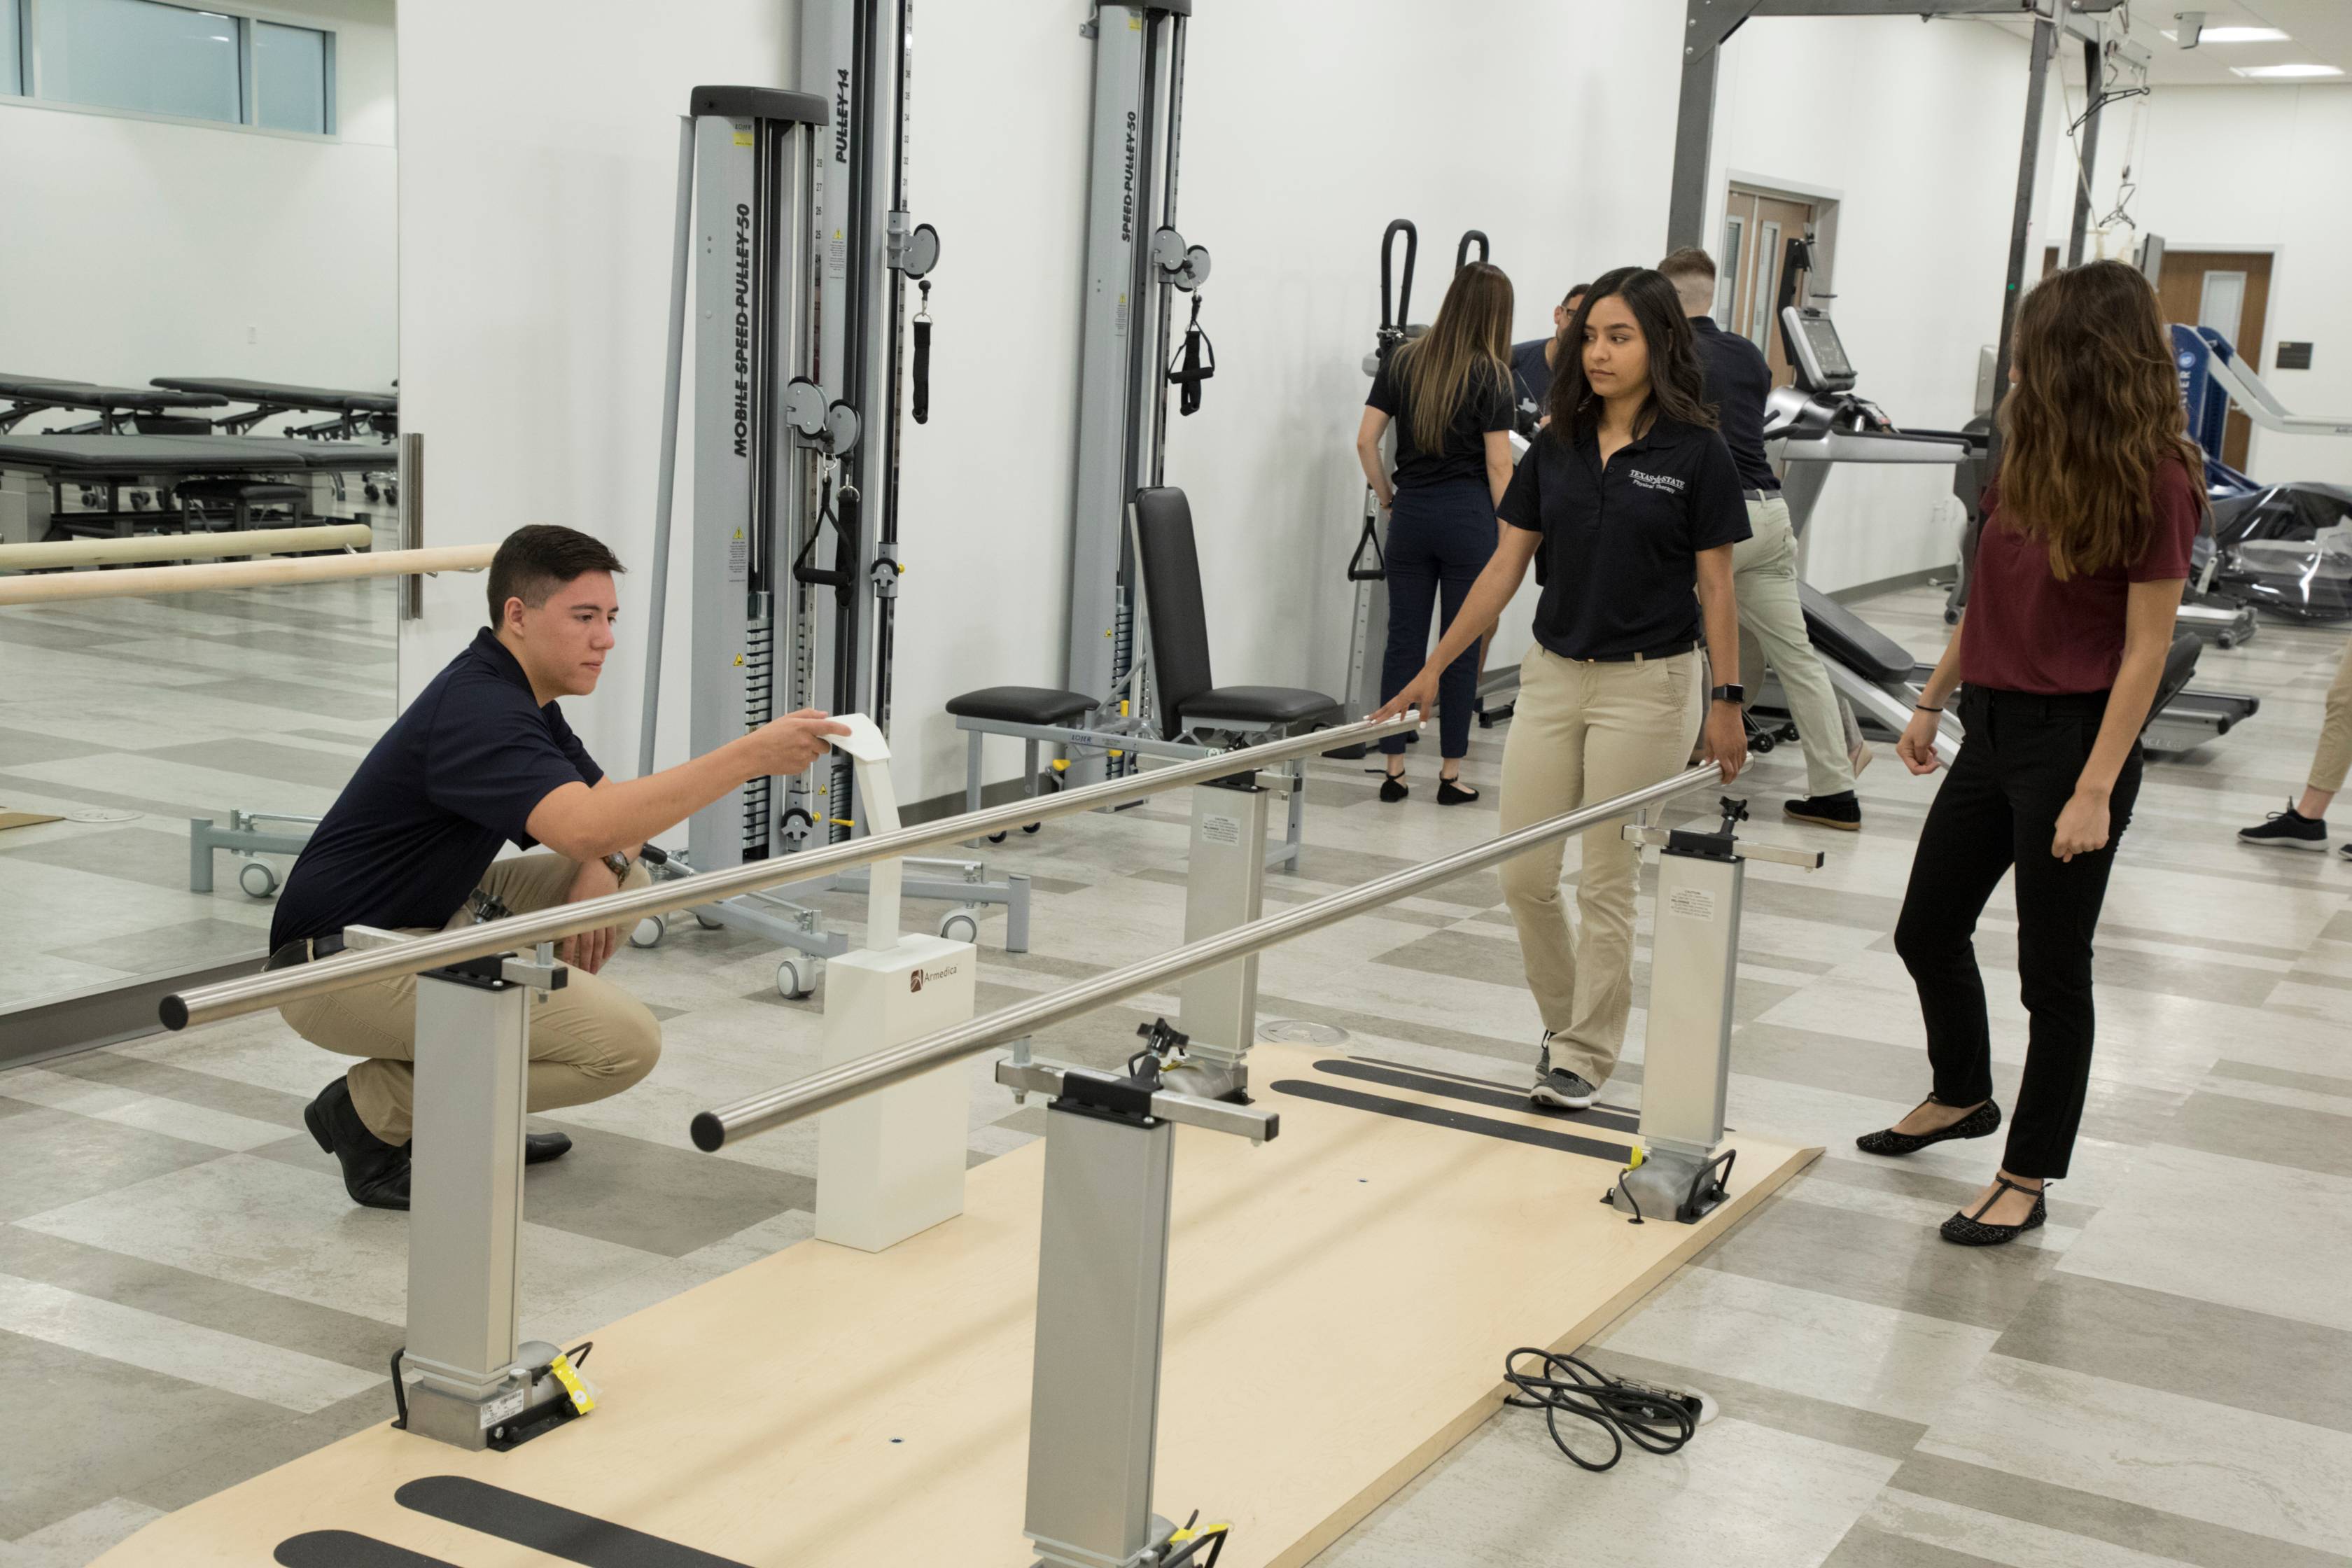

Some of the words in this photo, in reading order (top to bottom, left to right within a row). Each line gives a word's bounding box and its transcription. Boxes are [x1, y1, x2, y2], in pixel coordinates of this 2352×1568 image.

[837, 69, 849, 90] 14
[836, 93, 848, 164] PULLEY
[1127, 111, 1136, 132] 50
[816, 159, 823, 167] 28
[1124, 132, 1135, 192] PULLEY
[816, 183, 822, 192] 27
[736, 204, 750, 229] 50
[816, 206, 822, 216] 26
[1121, 195, 1133, 243] SPEED
[816, 230, 822, 239] 25
[736, 231, 749, 308] PULLEY
[735, 312, 748, 374] SPEED
[734, 379, 748, 458] MOBILE
[1630, 469, 1654, 481] TEXAS
[1661, 475, 1685, 487] STATE
[1632, 479, 1654, 489] Physical
[1656, 484, 1676, 494] Therapy
[925, 966, 957, 981] Armedica
